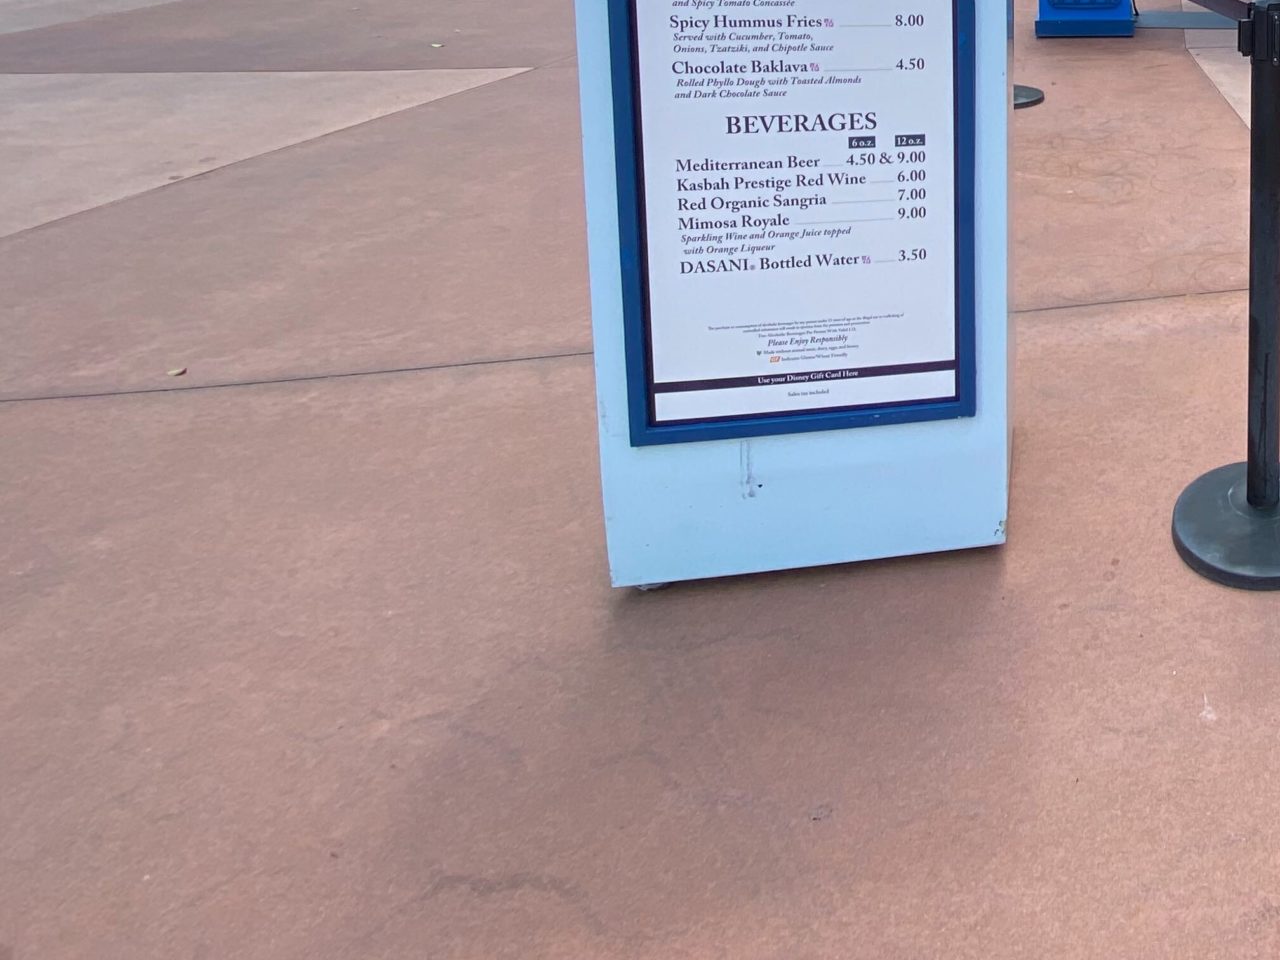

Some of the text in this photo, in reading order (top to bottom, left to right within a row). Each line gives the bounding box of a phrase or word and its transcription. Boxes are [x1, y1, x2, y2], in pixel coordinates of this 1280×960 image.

[672, 0, 690, 8] and
[692, 0, 715, 9] Spicy
[669, 14, 924, 31] Spicy Hummus Fries 8.00
[673, 32, 814, 42] Served with Cucumber, Tomato,
[673, 43, 834, 54] Onions, Tzatziki, and Chipotle Sauce
[672, 58, 925, 74] Chocolate Baklava 4.50
[677, 76, 862, 89] Rolled Phyllo Dough with Toasted Almonds
[675, 89, 788, 99] and Dark Chocolate Sauce
[725, 112, 877, 135] BEVERAGES
[897, 136, 907, 145] 12
[676, 151, 926, 173] Mediterranean Beer 4.50 & 9.00
[676, 170, 926, 192] Kasbah Prestige Red Wine 6.00
[677, 188, 926, 213] Red Organic Sangria 7.00
[678, 206, 926, 232] Mimosa Royale 9.00
[681, 227, 851, 245] Sparkling Wine and Orange Juice topped
[684, 244, 775, 257] with Orange Liqueur
[760, 256, 812, 271] Bottled
[815, 253, 860, 267] Water
[898, 249, 927, 262] 3.50
[768, 335, 848, 347] Please Enjoy Responsibly
[771, 376, 786, 384] your
[787, 374, 809, 383] Disney
[825, 371, 841, 379] Card
